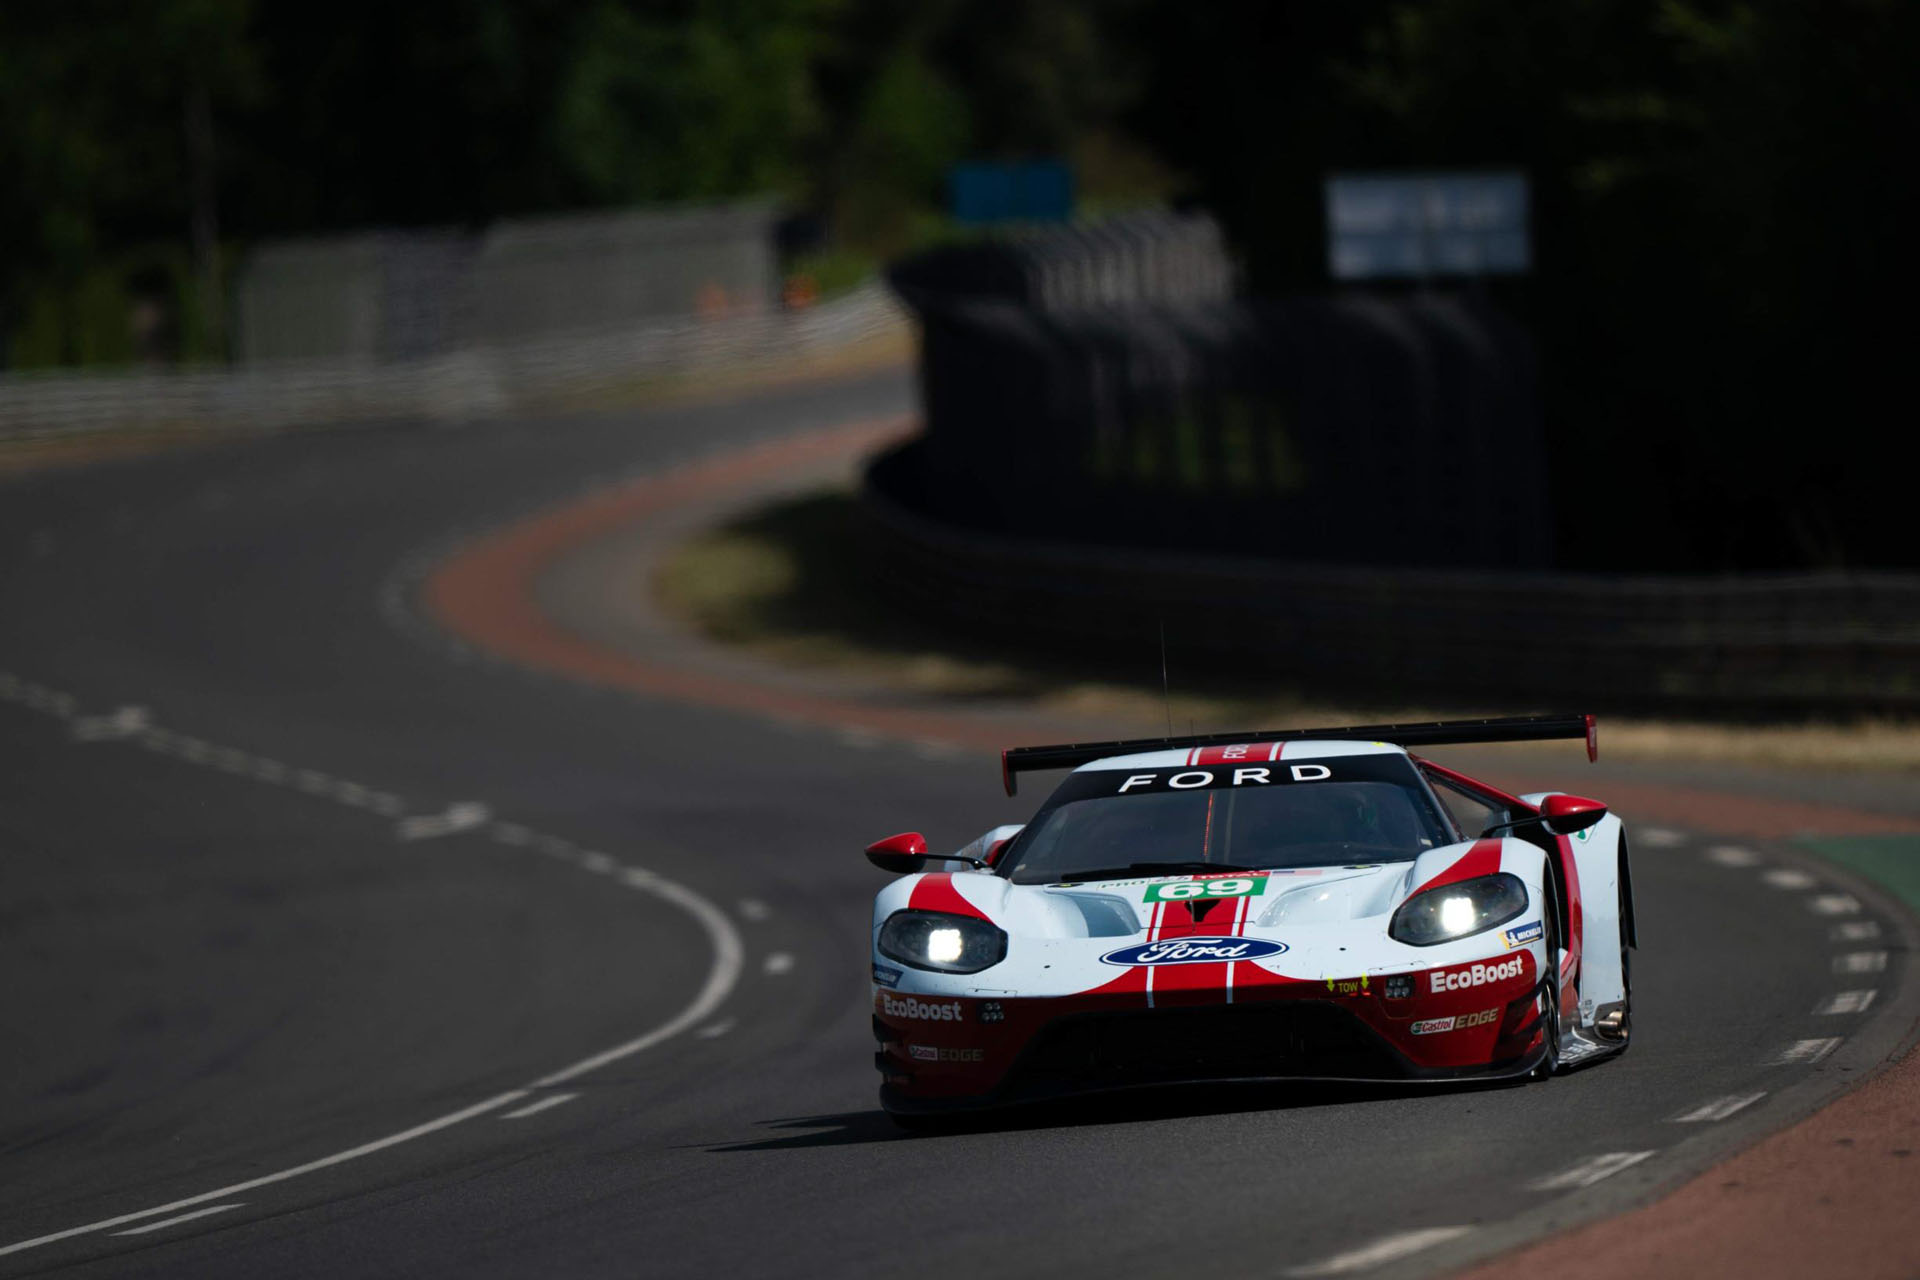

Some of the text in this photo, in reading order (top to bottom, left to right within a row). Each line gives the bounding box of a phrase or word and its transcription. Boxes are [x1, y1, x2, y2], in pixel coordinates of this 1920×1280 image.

[1118, 764, 1331, 793] FORD
[1158, 879, 1254, 899] 69
[1137, 939, 1247, 963] Ford
[1430, 955, 1523, 994] EcoBoost
[1338, 982, 1358, 993] TOW
[883, 993, 963, 1021] EcoBoost
[1421, 1007, 1499, 1033] Castrol EDGE
[938, 1048, 985, 1061] EDGE
